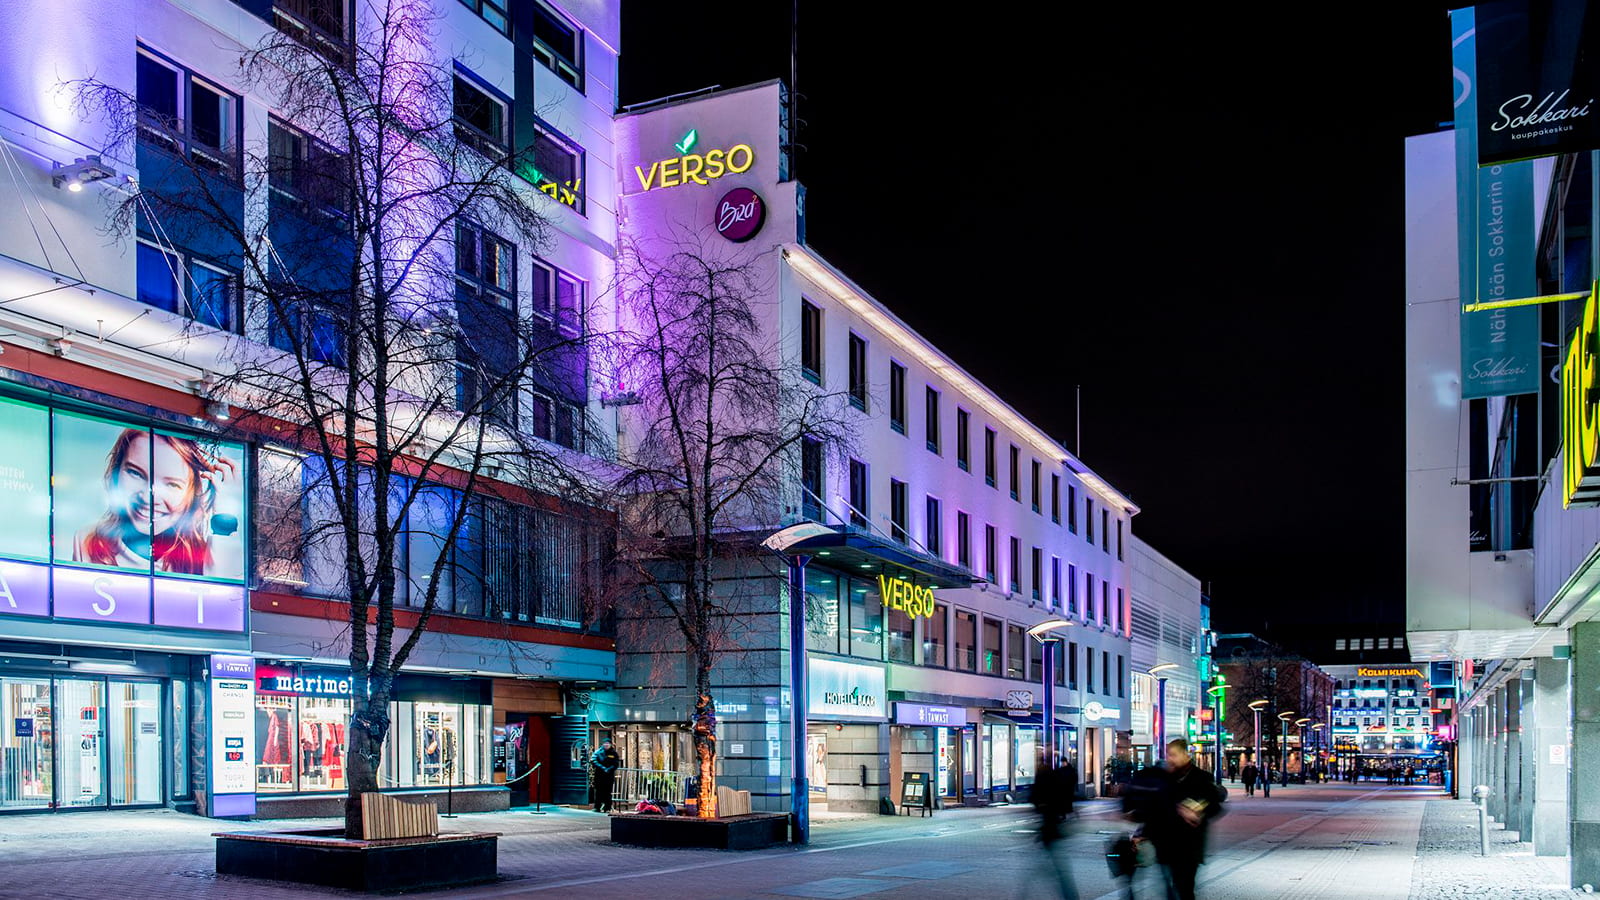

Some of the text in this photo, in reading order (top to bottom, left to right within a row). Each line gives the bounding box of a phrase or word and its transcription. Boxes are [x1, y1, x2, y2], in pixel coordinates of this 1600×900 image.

[1490, 89, 1594, 132] Sokkari
[1511, 124, 1574, 140] kauppakeskus
[635, 144, 754, 191] VERSO
[1487, 180, 1504, 257] Sokkarin
[1489, 262, 1506, 343] Nähään
[1468, 356, 1529, 380] Sokkari
[880, 574, 934, 619] VERSO
[226, 665, 251, 673] TAWAST
[928, 713, 949, 724] TAWAST
